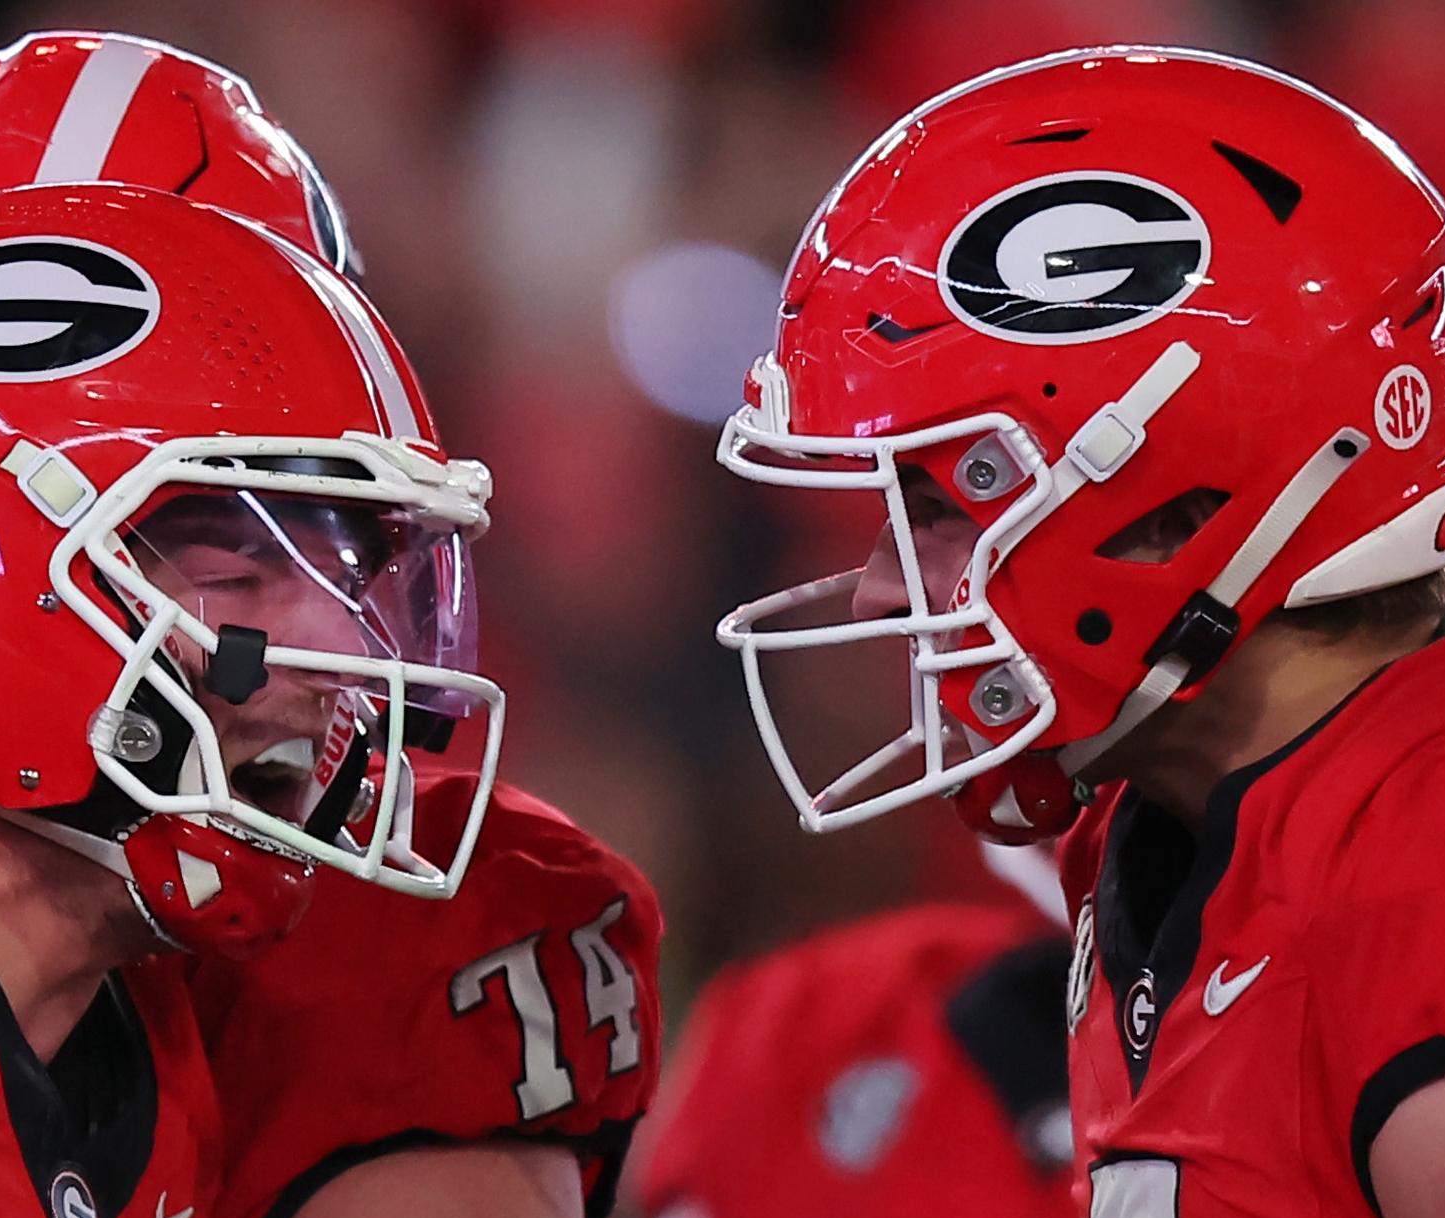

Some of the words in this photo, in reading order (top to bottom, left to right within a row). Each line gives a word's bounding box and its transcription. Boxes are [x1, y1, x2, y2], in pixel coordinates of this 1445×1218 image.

[945, 178, 1204, 335] G
[1381, 373, 1425, 441] SEC
[448, 893, 642, 1122] 74
